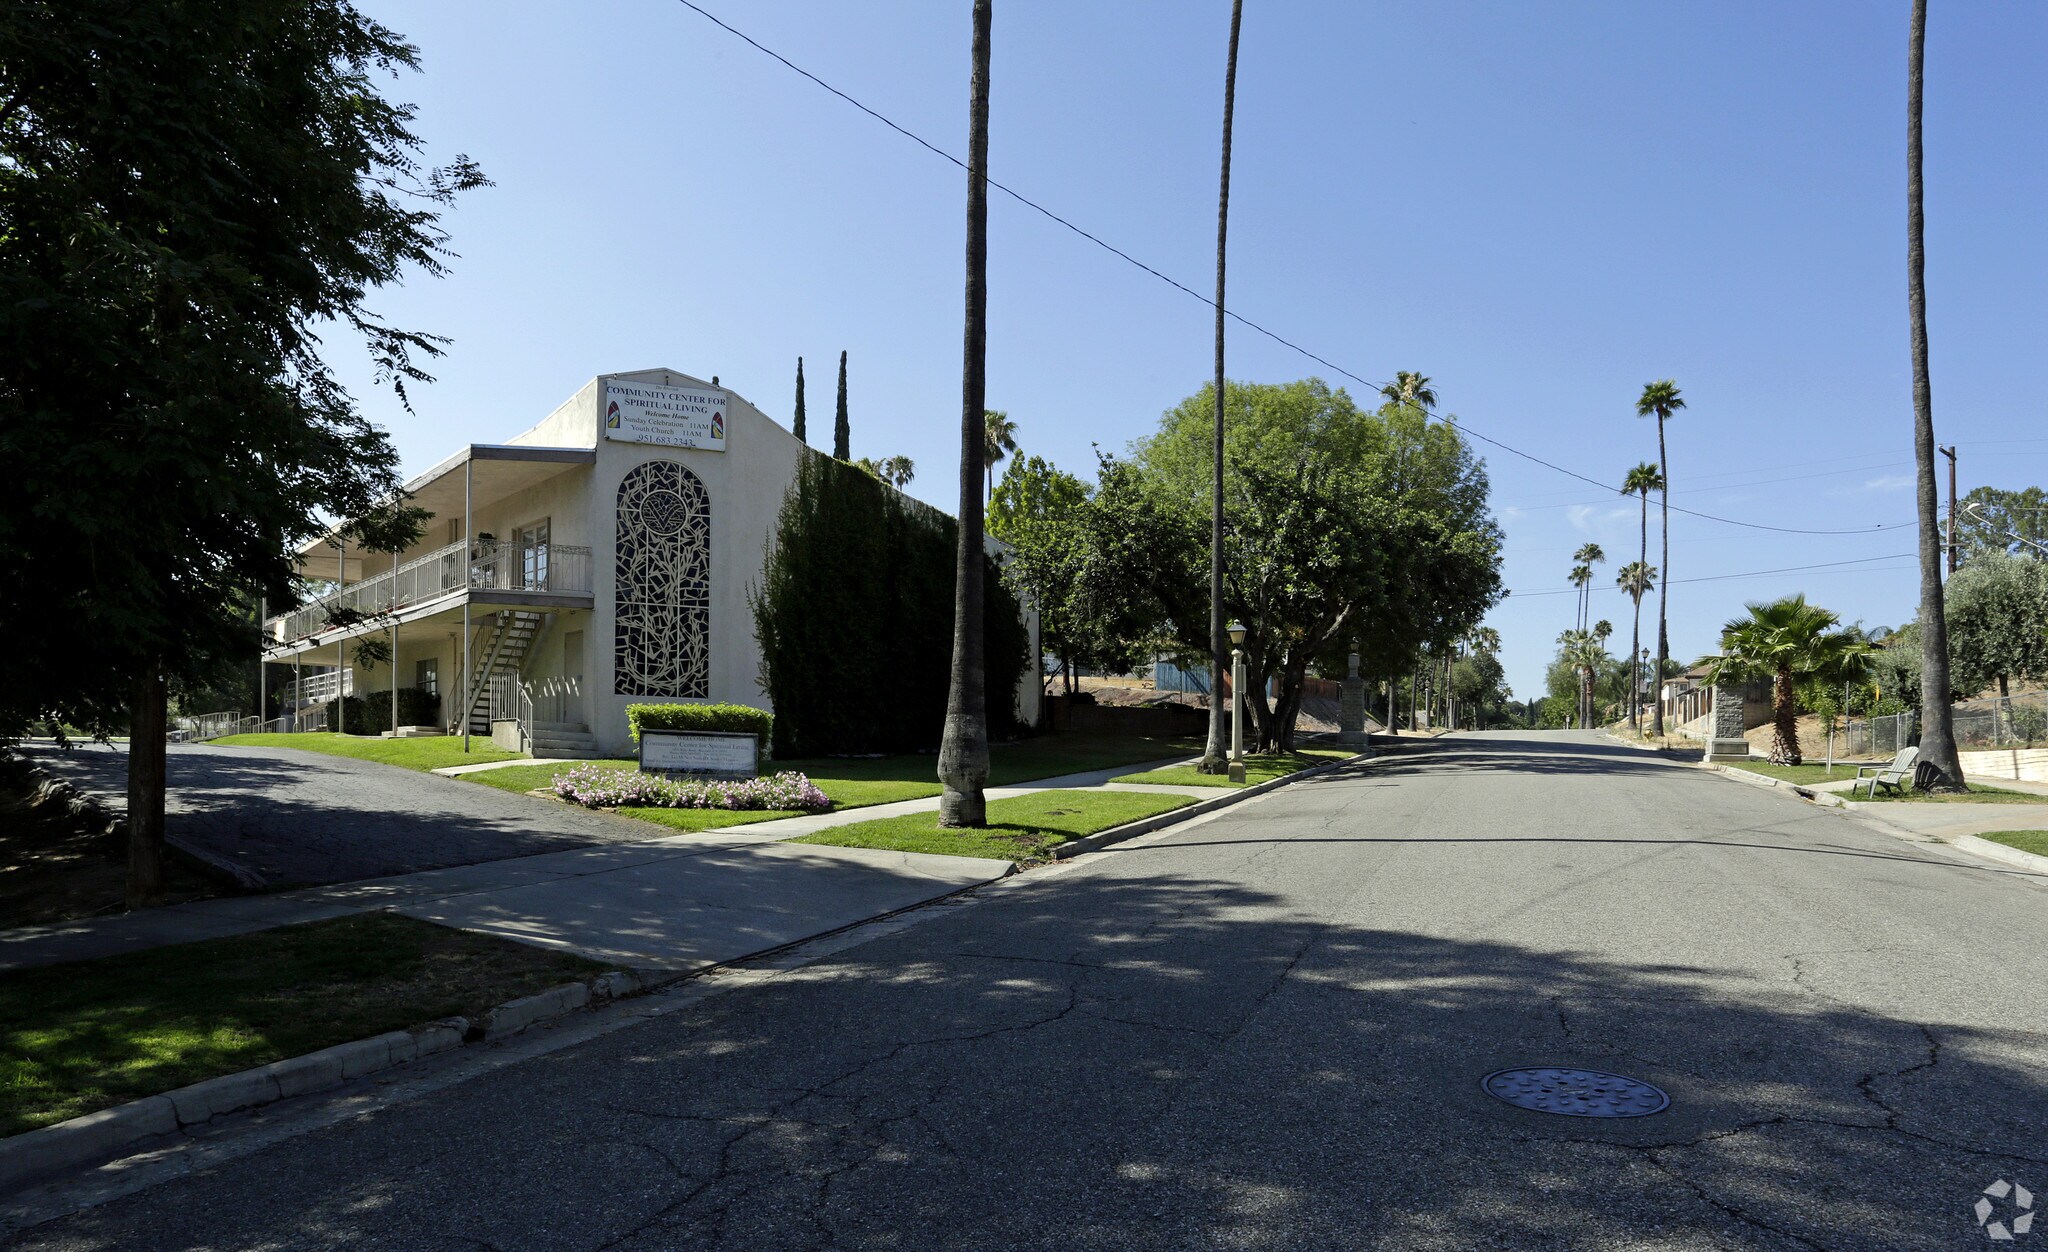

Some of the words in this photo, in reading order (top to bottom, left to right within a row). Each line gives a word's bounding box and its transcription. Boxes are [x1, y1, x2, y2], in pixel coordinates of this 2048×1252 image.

[607, 386, 667, 399] COMMUNITY
[669, 393, 705, 404] CENTER
[708, 397, 726, 406] FOR
[624, 398, 674, 410] SPIRITUAL
[676, 404, 708, 414] LIVING
[645, 410, 670, 418] Welcome
[623, 415, 646, 425] Sunday
[648, 418, 684, 428] Celebration
[690, 422, 709, 430] 11AM
[631, 425, 650, 433] Youth
[651, 427, 675, 435] Church
